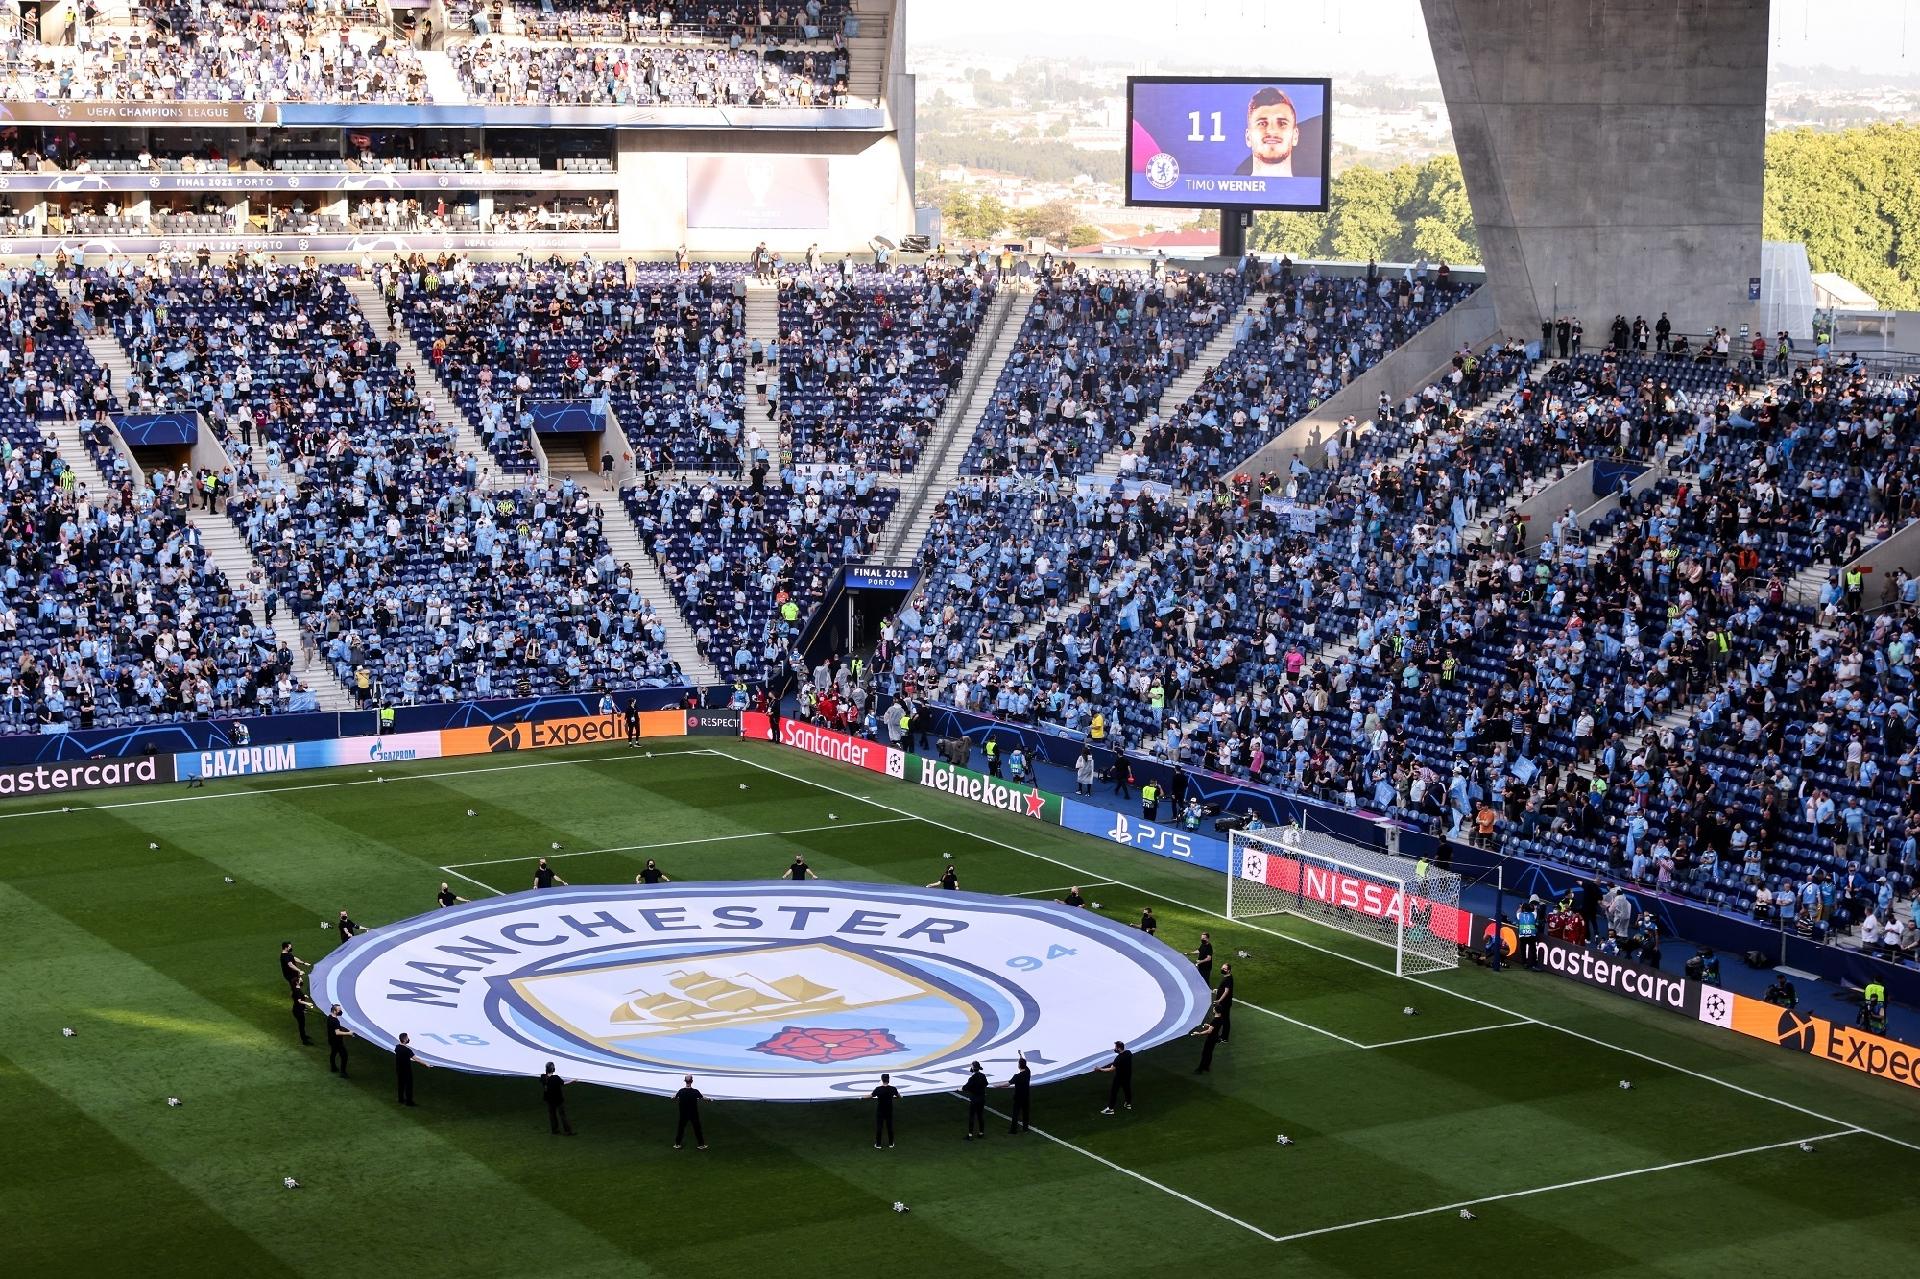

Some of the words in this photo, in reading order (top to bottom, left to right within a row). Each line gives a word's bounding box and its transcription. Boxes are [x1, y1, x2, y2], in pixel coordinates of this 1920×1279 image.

[87, 107, 116, 116] UEFA
[119, 107, 183, 117] CHAMPIONS
[187, 108, 229, 117] LEAGUE
[1187, 111, 1226, 142] 11
[176, 178, 204, 187] FINAL
[208, 178, 233, 187] 2021
[236, 178, 274, 187] PORTO
[1185, 179, 1215, 191] TIMO
[1217, 180, 1266, 192] WERNER
[219, 240, 243, 250] 202
[247, 240, 283, 250] PORTO
[853, 567, 882, 577] FINAL
[885, 569, 909, 579] 2021
[868, 578, 895, 587] PORTO
[701, 717, 740, 728] RESPECT
[785, 720, 869, 767] Santander
[201, 744, 296, 778] GAZPROM
[383, 749, 416, 761] GAZPROM
[920, 757, 1022, 813] Heineken
[1137, 823, 1191, 858] PS5
[386, 904, 970, 1009] MANCHESTER
[1005, 942, 1078, 972] 94
[1526, 941, 1685, 1008] mastercard
[419, 1032, 491, 1047] 18
